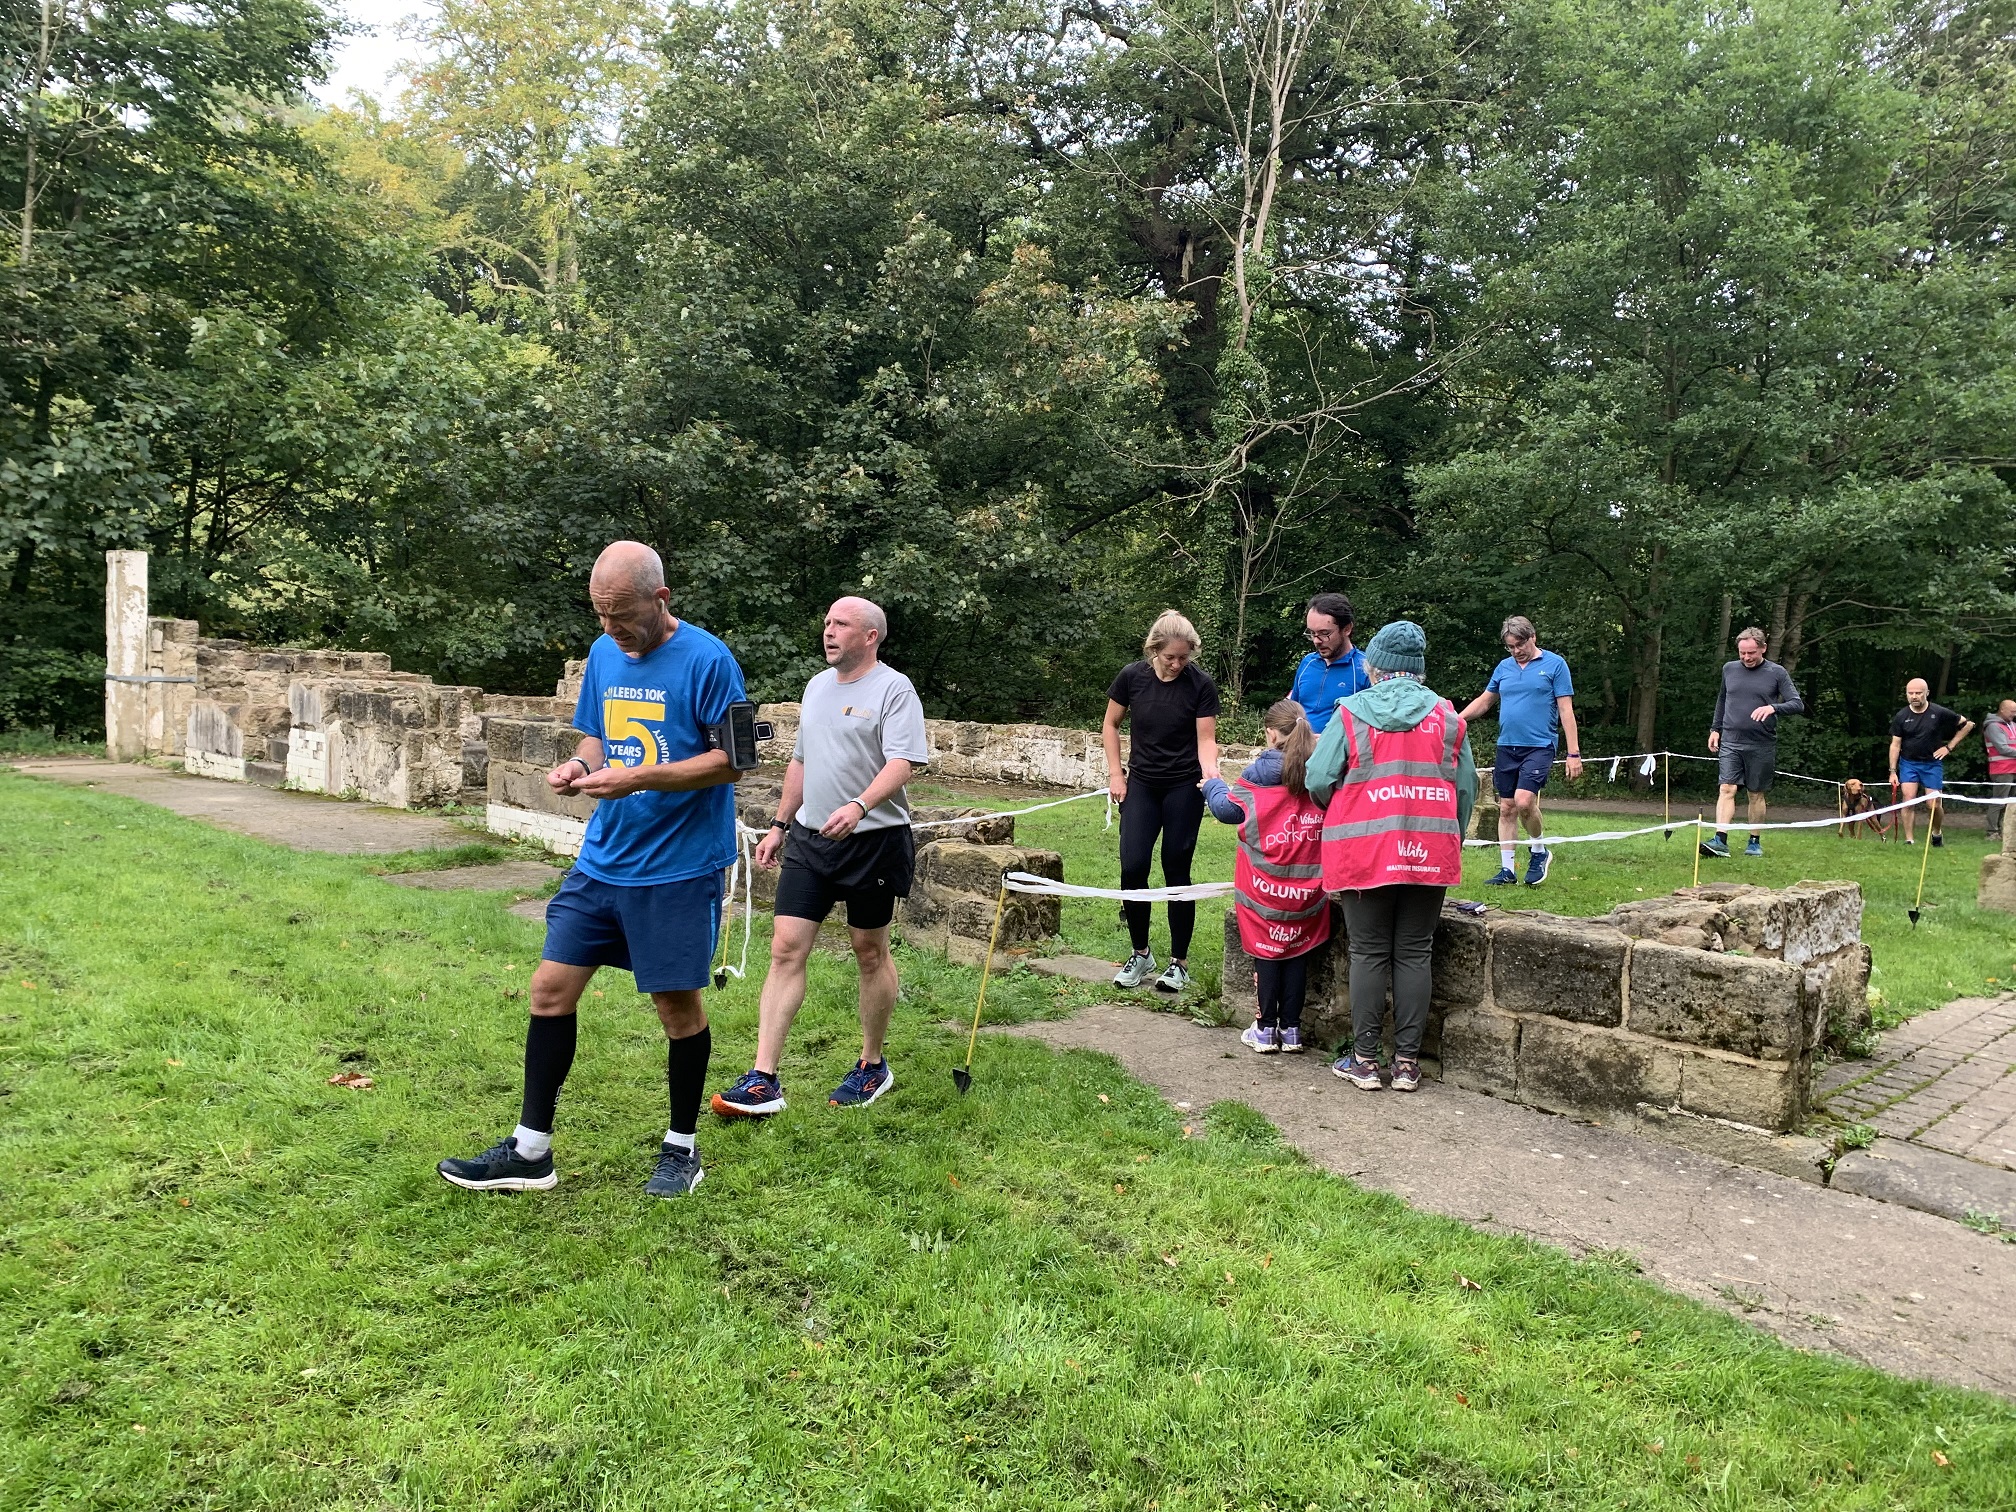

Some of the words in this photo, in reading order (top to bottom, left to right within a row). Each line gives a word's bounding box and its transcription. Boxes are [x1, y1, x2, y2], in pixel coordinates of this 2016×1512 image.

[612, 686, 644, 700] LEEDS
[644, 688, 666, 702] 10K
[608, 744, 642, 757] YEARS
[625, 757, 636, 767] OF
[1367, 784, 1451, 803] VOLUNTEER
[1299, 813, 1324, 824] Vitalit
